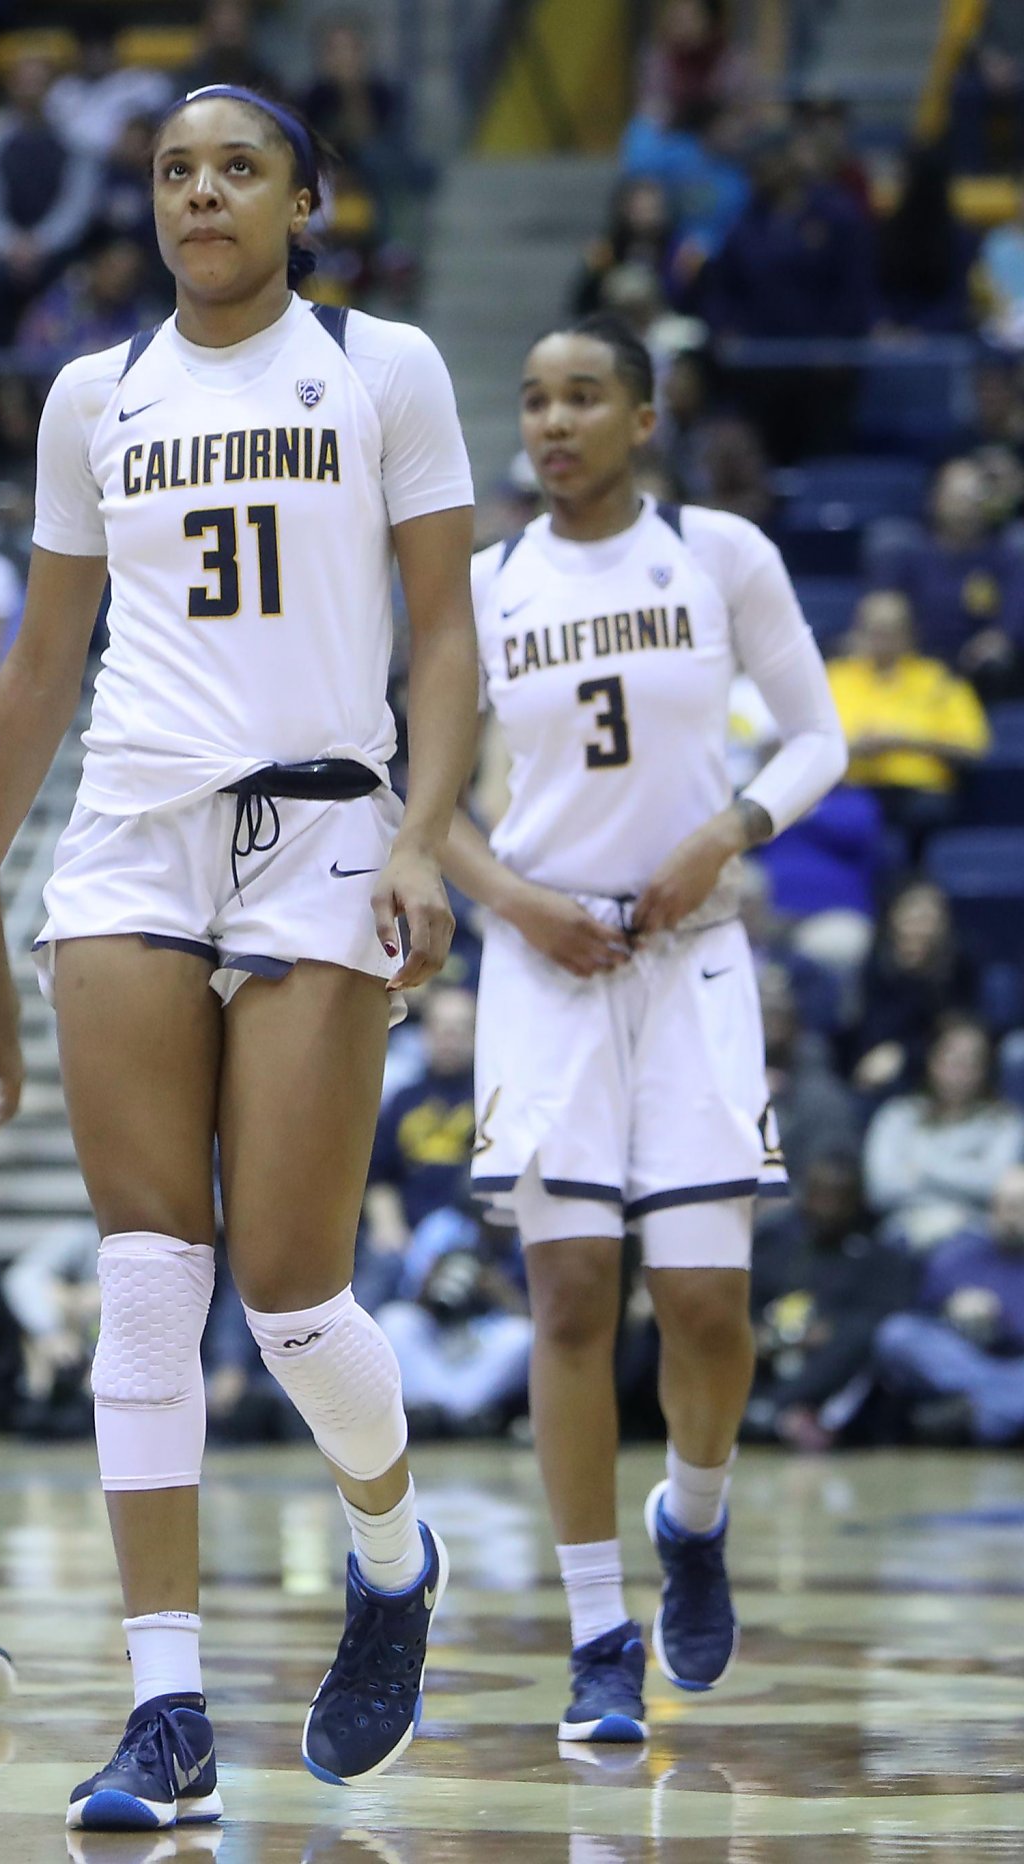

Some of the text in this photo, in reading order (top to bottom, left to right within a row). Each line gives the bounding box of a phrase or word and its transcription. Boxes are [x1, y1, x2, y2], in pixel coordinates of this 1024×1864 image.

[122, 427, 340, 498] CALIFORNIA
[183, 504, 284, 621] 31
[503, 604, 694, 682] CALIFORNIA
[578, 672, 632, 770] 3
